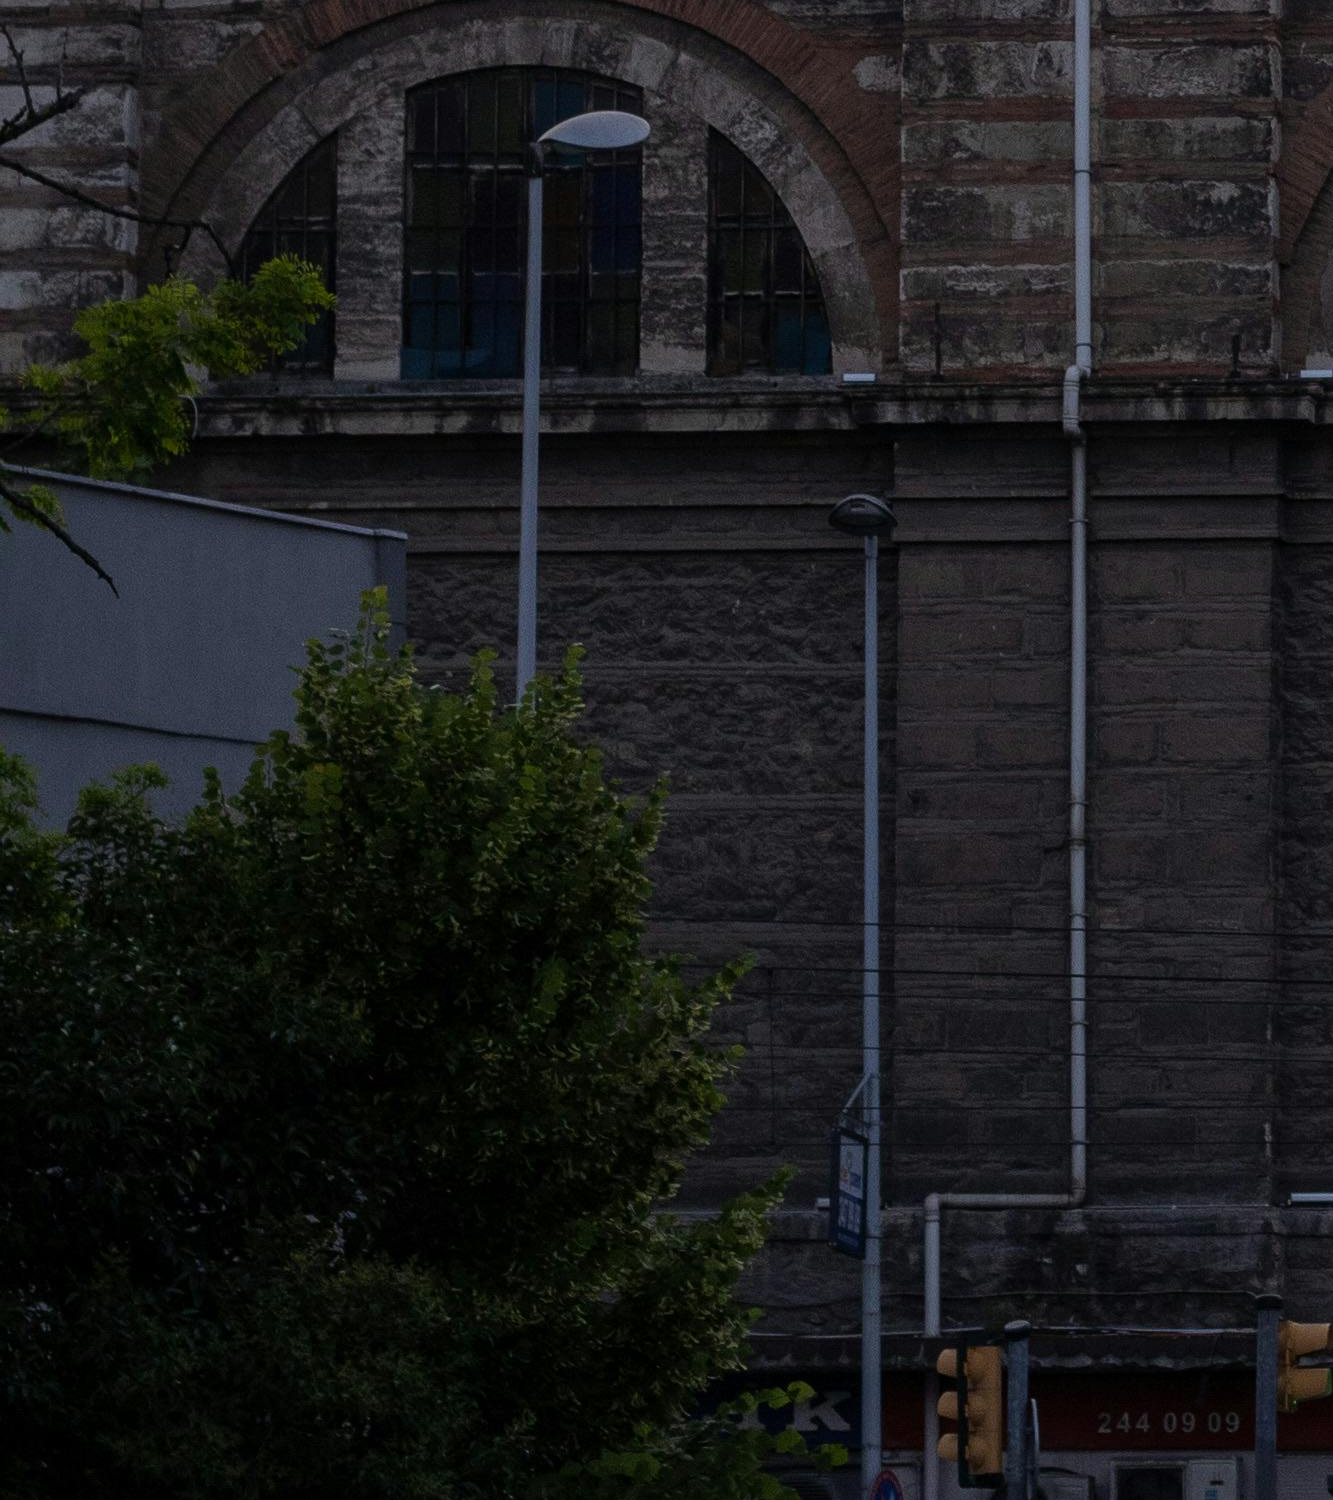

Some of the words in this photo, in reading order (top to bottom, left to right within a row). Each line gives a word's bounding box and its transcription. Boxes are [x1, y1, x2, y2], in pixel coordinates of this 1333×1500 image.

[1098, 1411, 1151, 1434] 244
[1163, 1411, 1196, 1434] 09
[1208, 1411, 1241, 1434] 09
